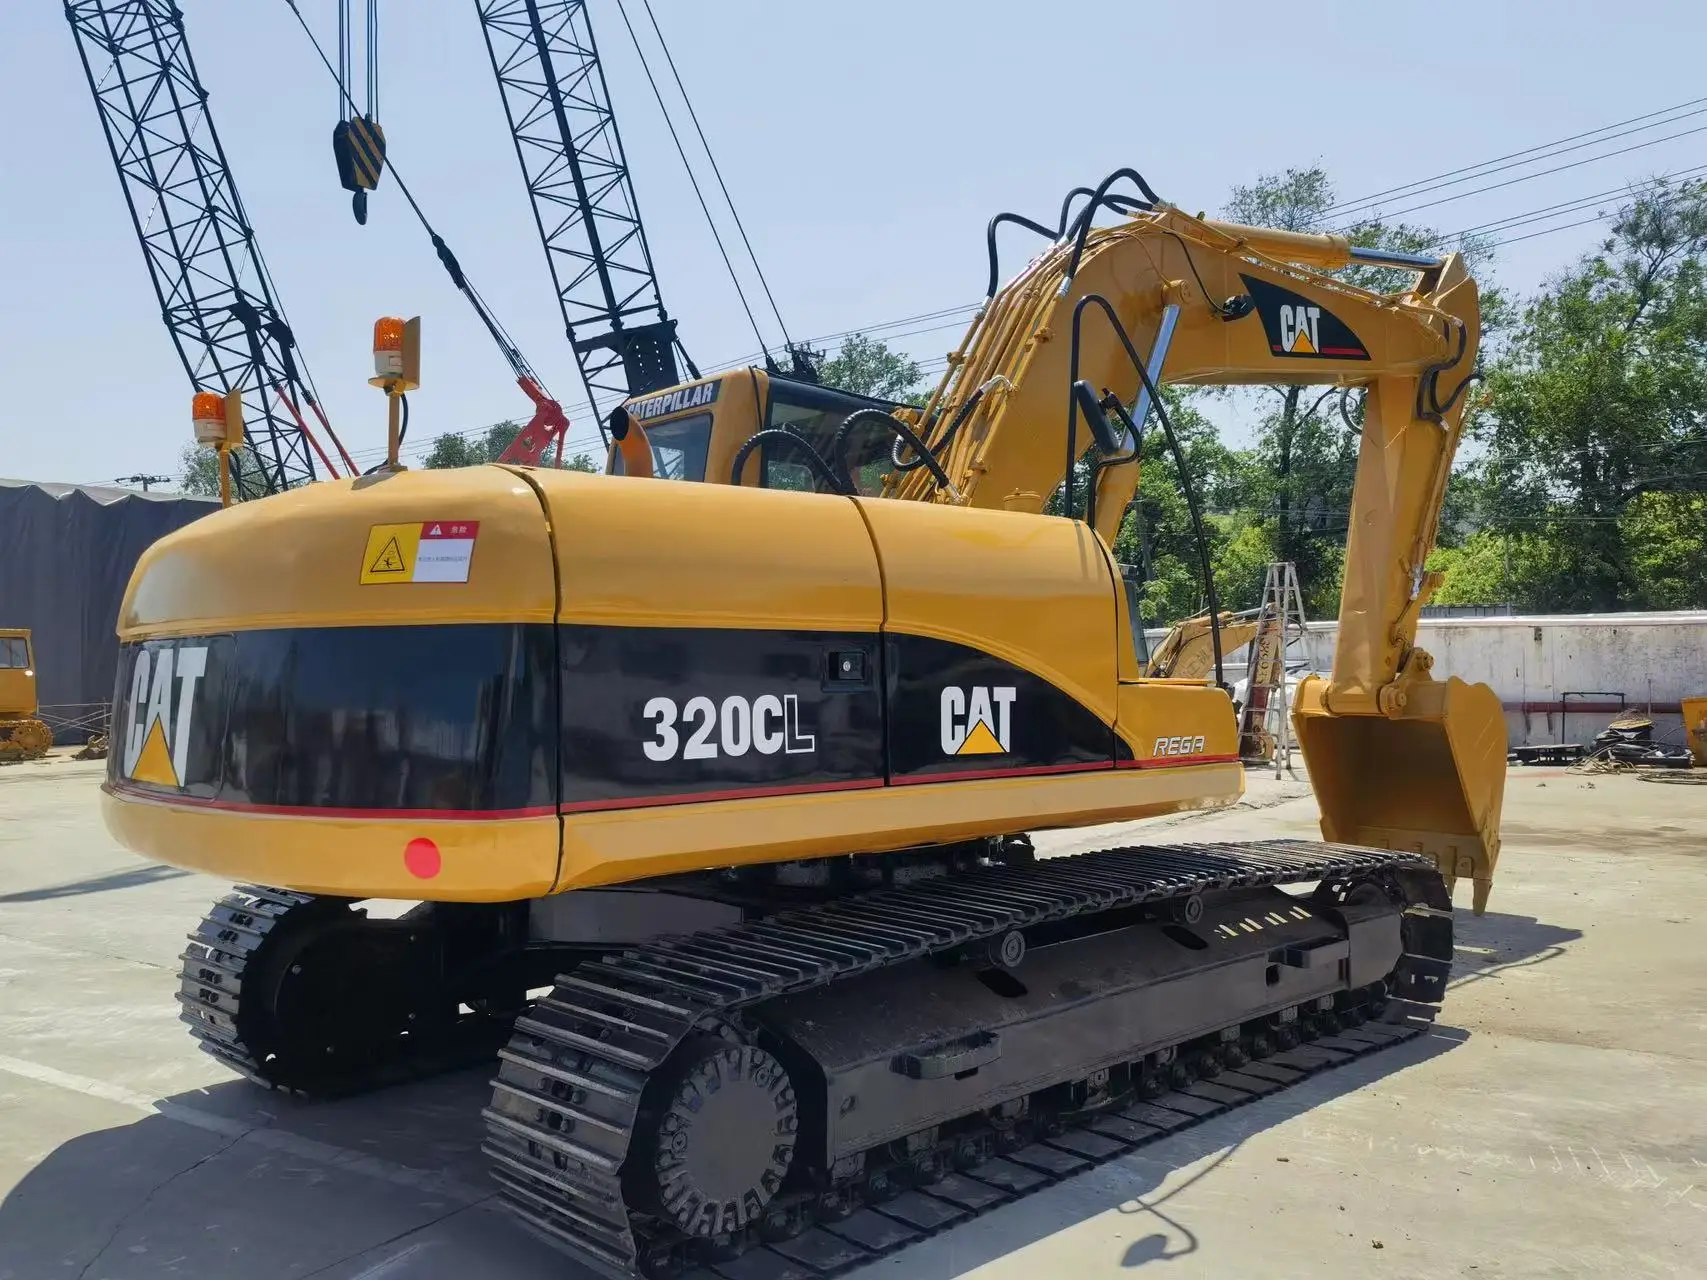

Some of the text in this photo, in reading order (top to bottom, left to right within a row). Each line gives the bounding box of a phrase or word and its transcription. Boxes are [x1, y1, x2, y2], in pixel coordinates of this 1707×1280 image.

[1280, 304, 1320, 354] CAT
[123, 646, 209, 788] CAT
[643, 693, 816, 761] 320CL
[940, 686, 1017, 755] CAT
[1153, 735, 1205, 757] REGA
